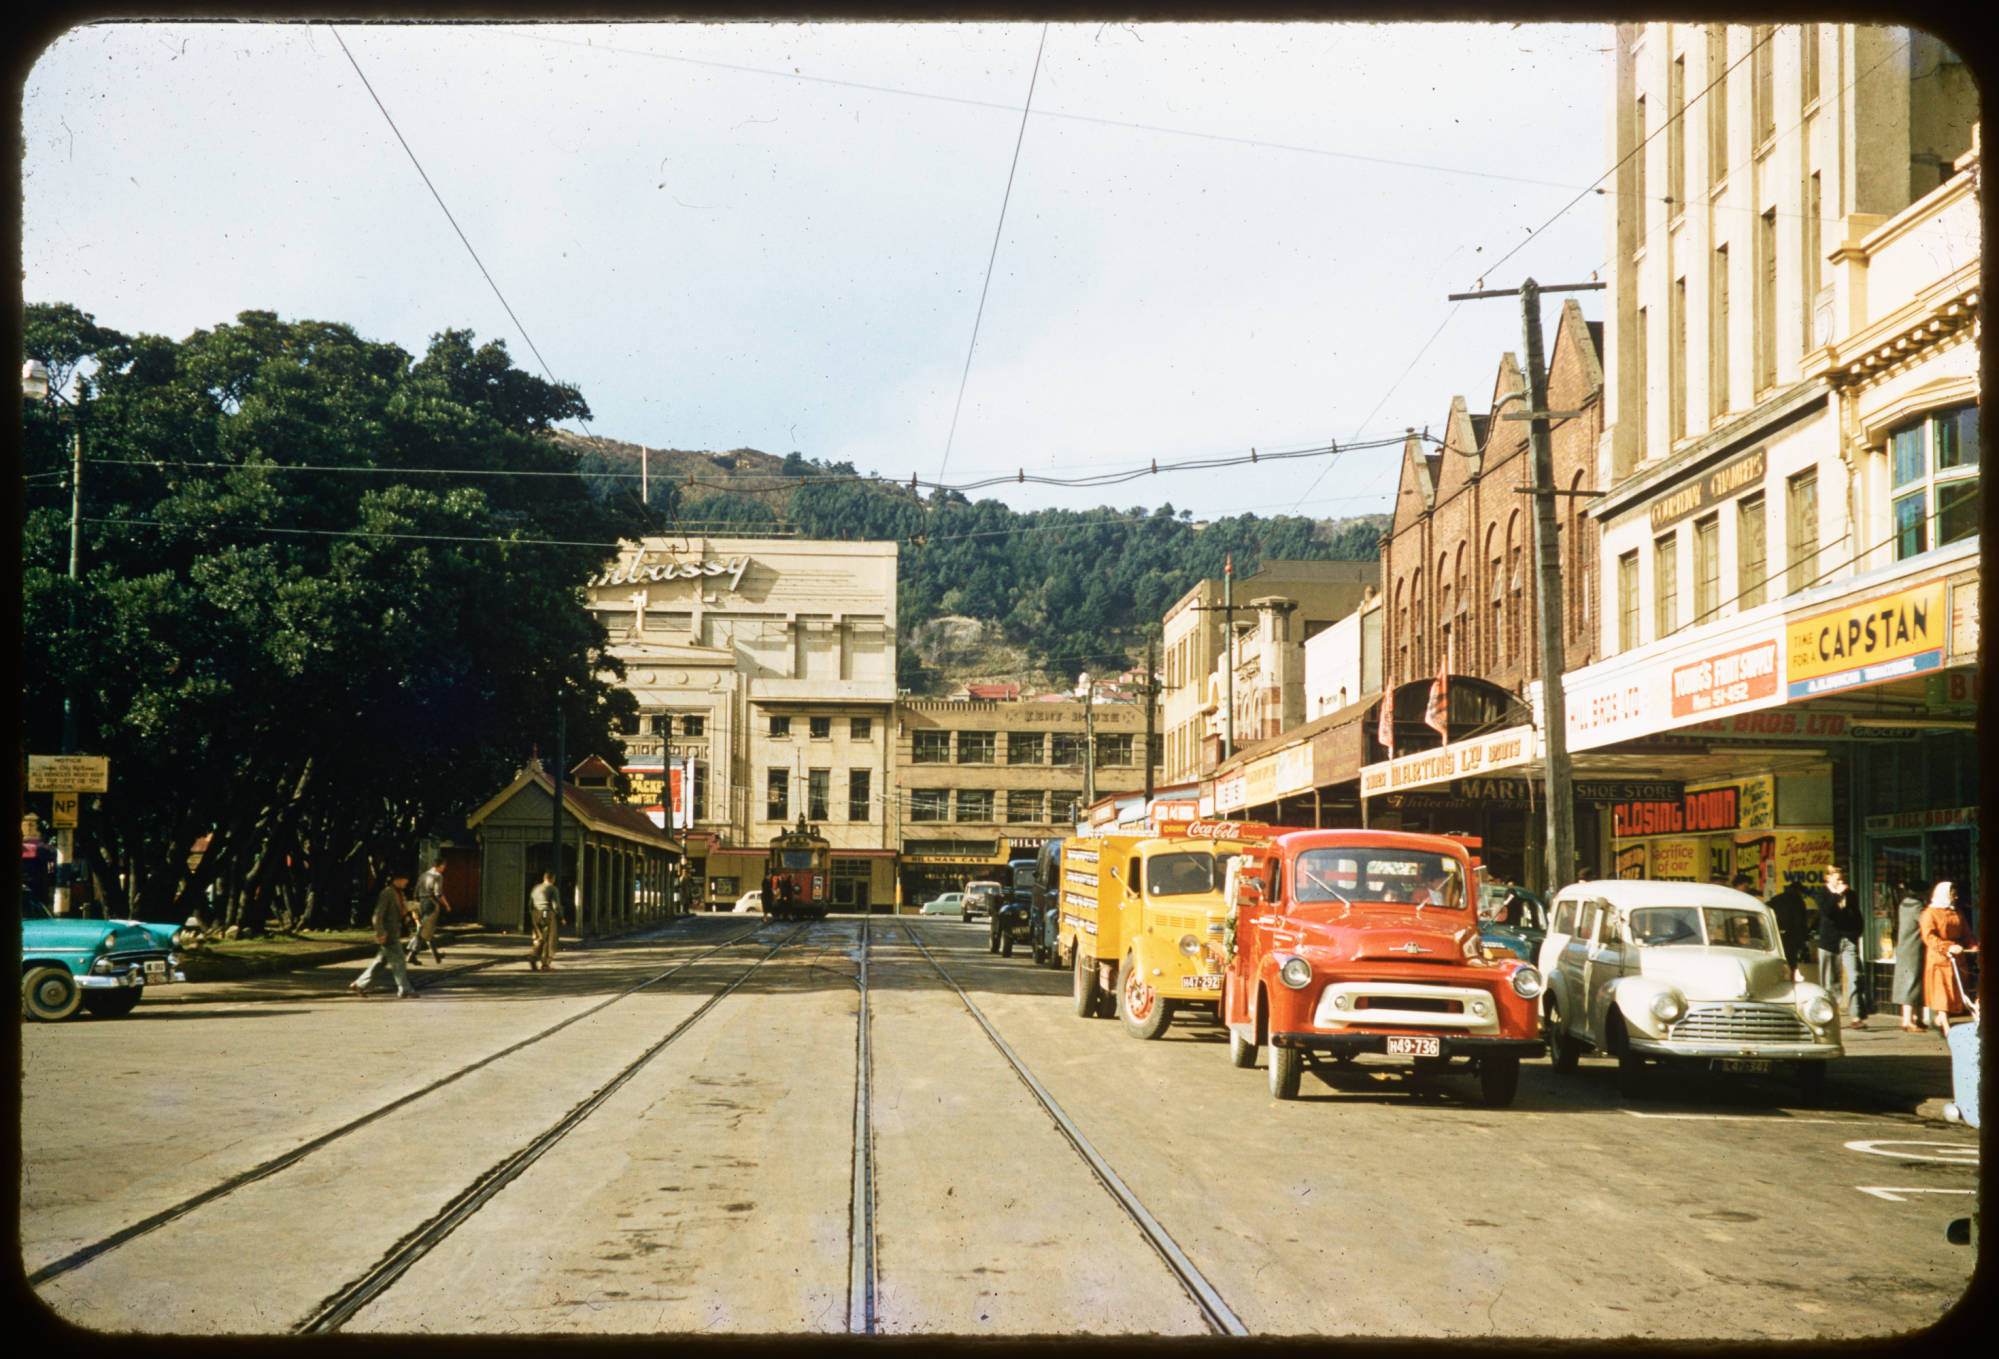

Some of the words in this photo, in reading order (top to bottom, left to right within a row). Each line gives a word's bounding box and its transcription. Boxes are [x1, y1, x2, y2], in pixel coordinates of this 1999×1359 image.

[587, 545, 750, 592] mbassy
[1818, 598, 1928, 662] CAPSTAN
[1793, 632, 1813, 648] TIME
[1792, 654, 1809, 667] FOR
[1811, 652, 1817, 664] A
[1071, 711, 1120, 723] HUSE
[1576, 784, 1617, 798] SHOE
[1624, 784, 1675, 798] STORE
[55, 800, 76, 813] NP
[1614, 801, 1683, 837] CLOSING
[1686, 788, 1736, 831] DOWN
[1657, 861, 1671, 874] of
[1671, 861, 1689, 872] our
[1783, 870, 1827, 884] WHOL
